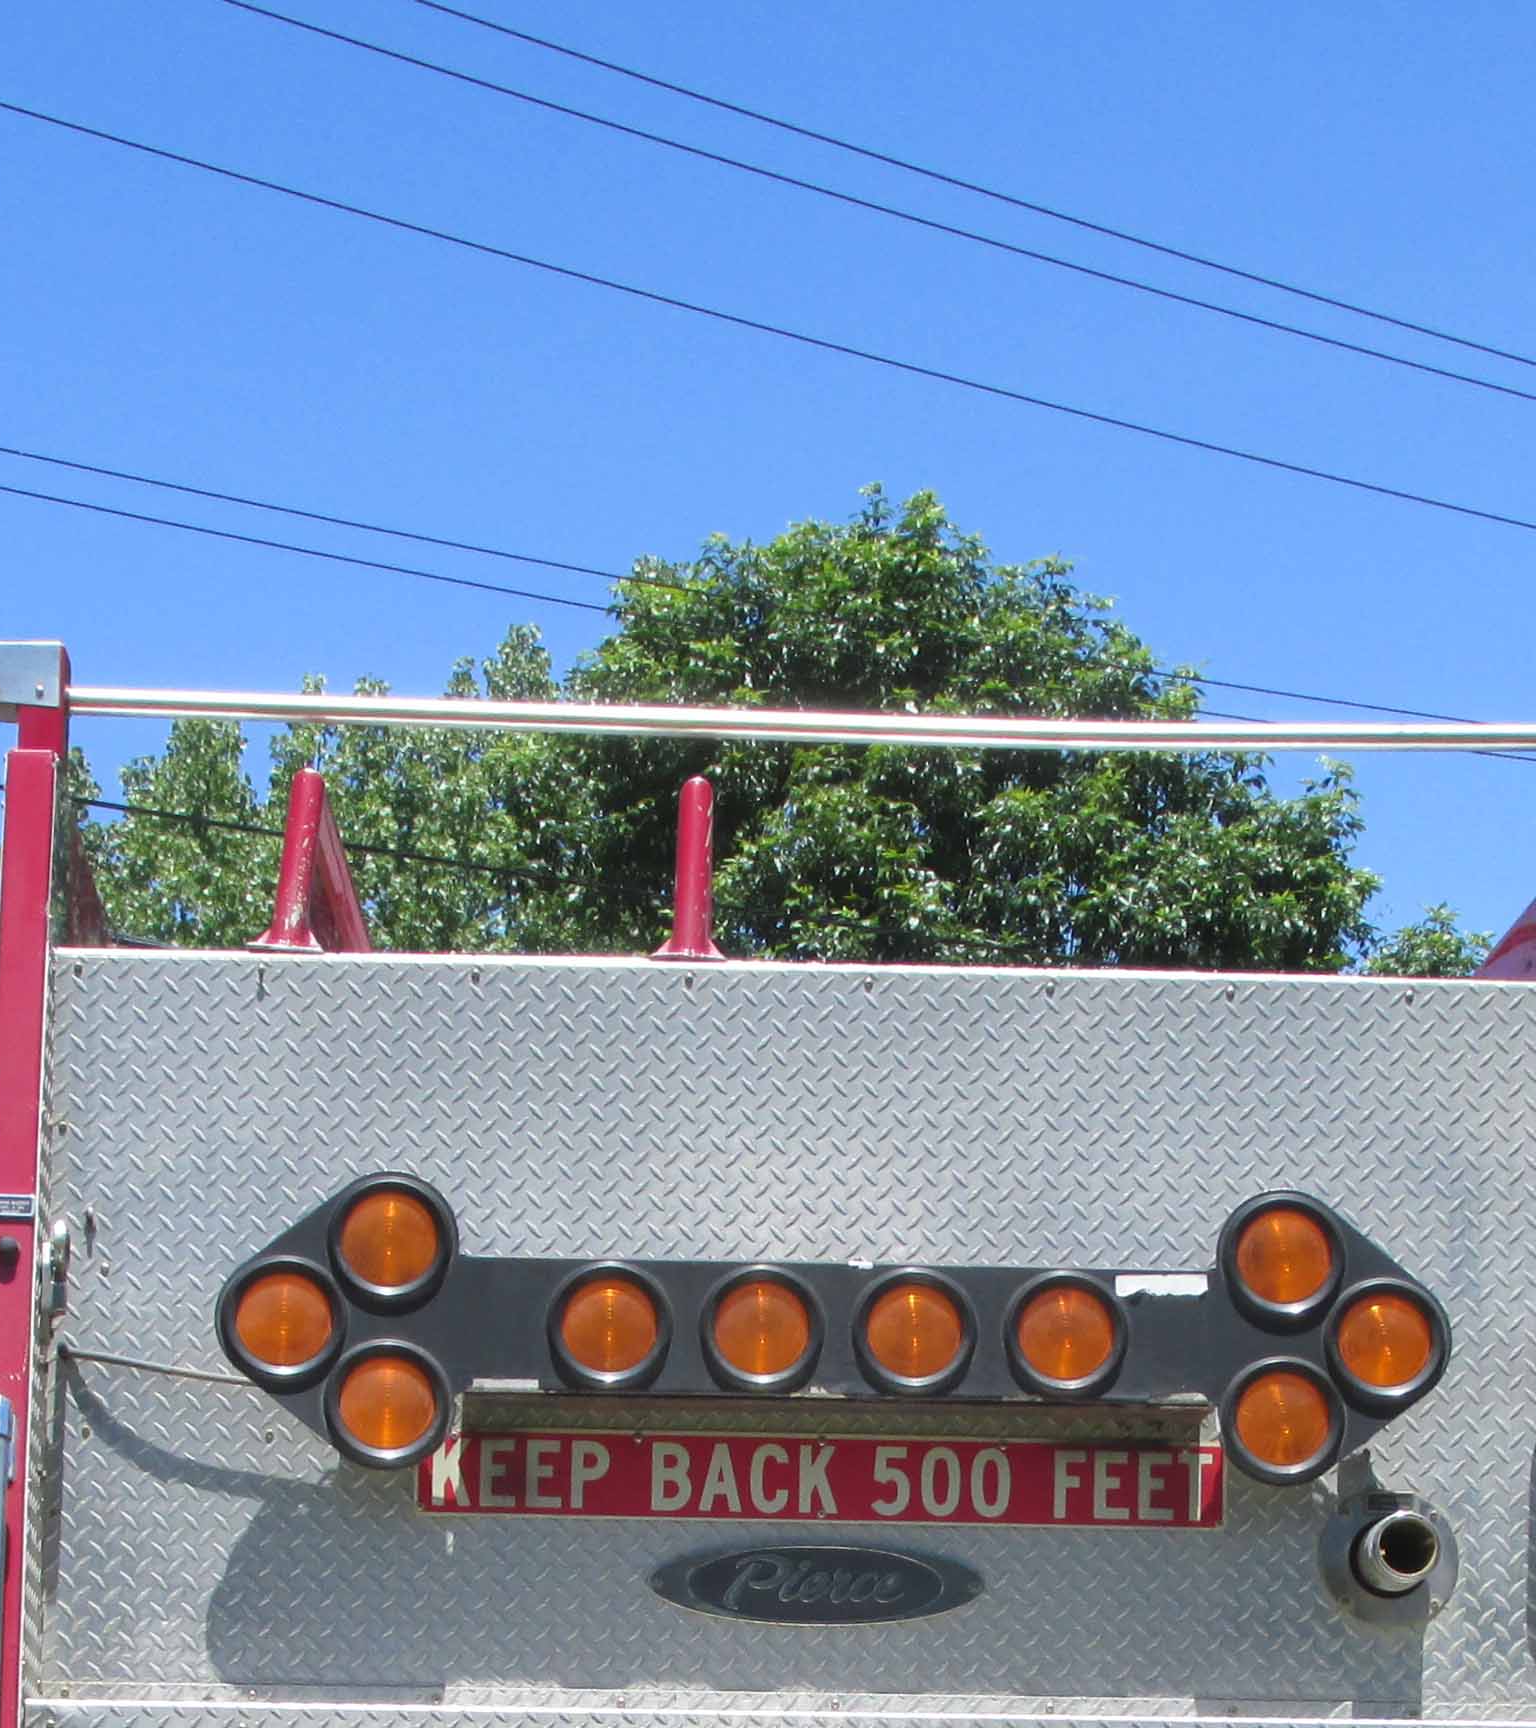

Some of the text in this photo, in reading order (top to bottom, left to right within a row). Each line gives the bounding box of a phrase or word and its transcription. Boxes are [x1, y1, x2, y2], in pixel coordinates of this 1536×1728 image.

[429, 1437, 1213, 1522] KEEP BACK 500 FEET
[725, 1554, 905, 1611] Pierce
